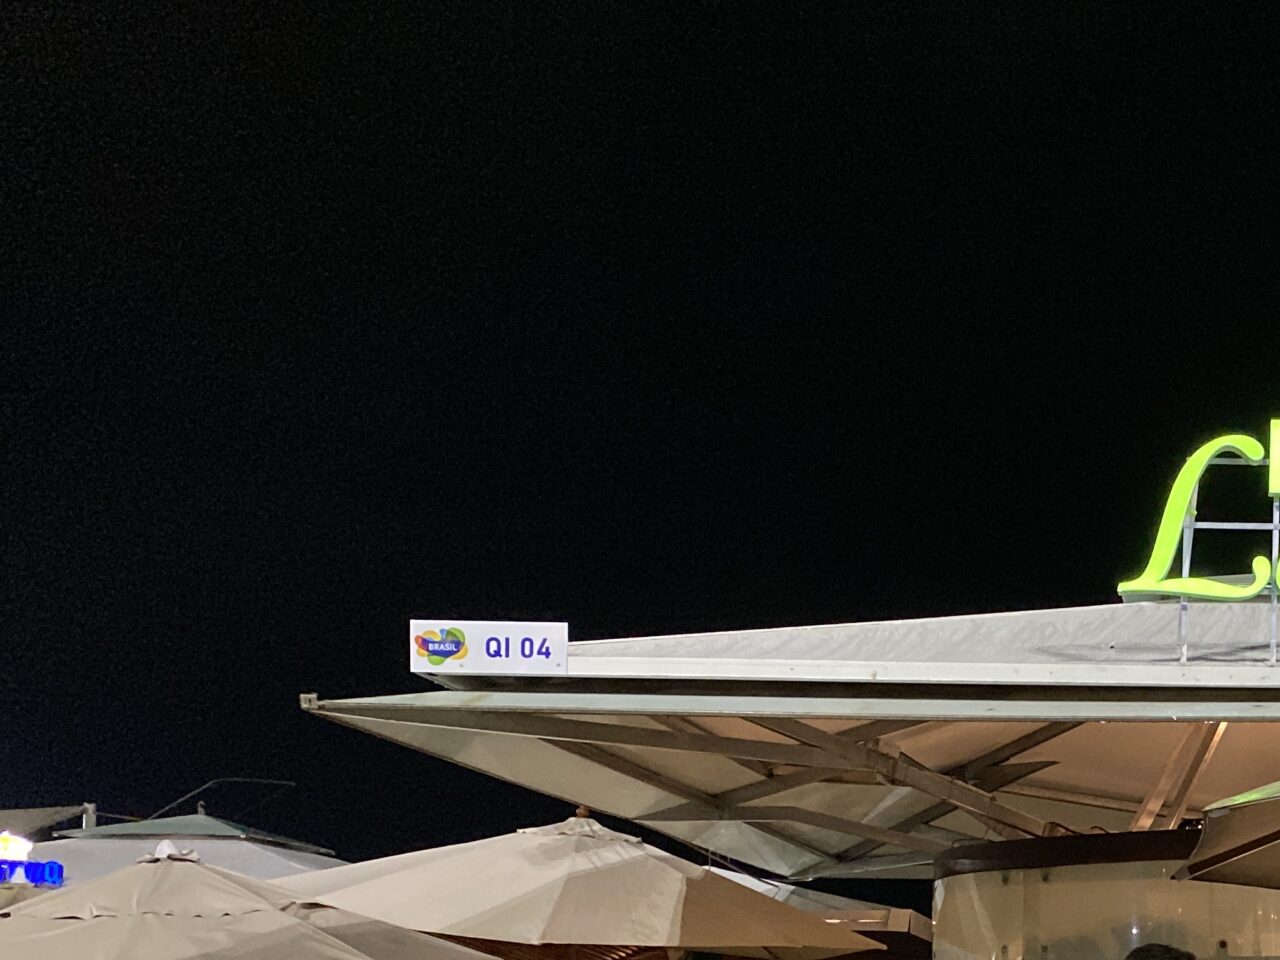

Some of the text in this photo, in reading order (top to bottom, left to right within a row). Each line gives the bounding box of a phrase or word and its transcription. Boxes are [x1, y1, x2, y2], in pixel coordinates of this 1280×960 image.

[428, 643, 458, 651] BRASIL
[485, 637, 552, 659] QI 04
